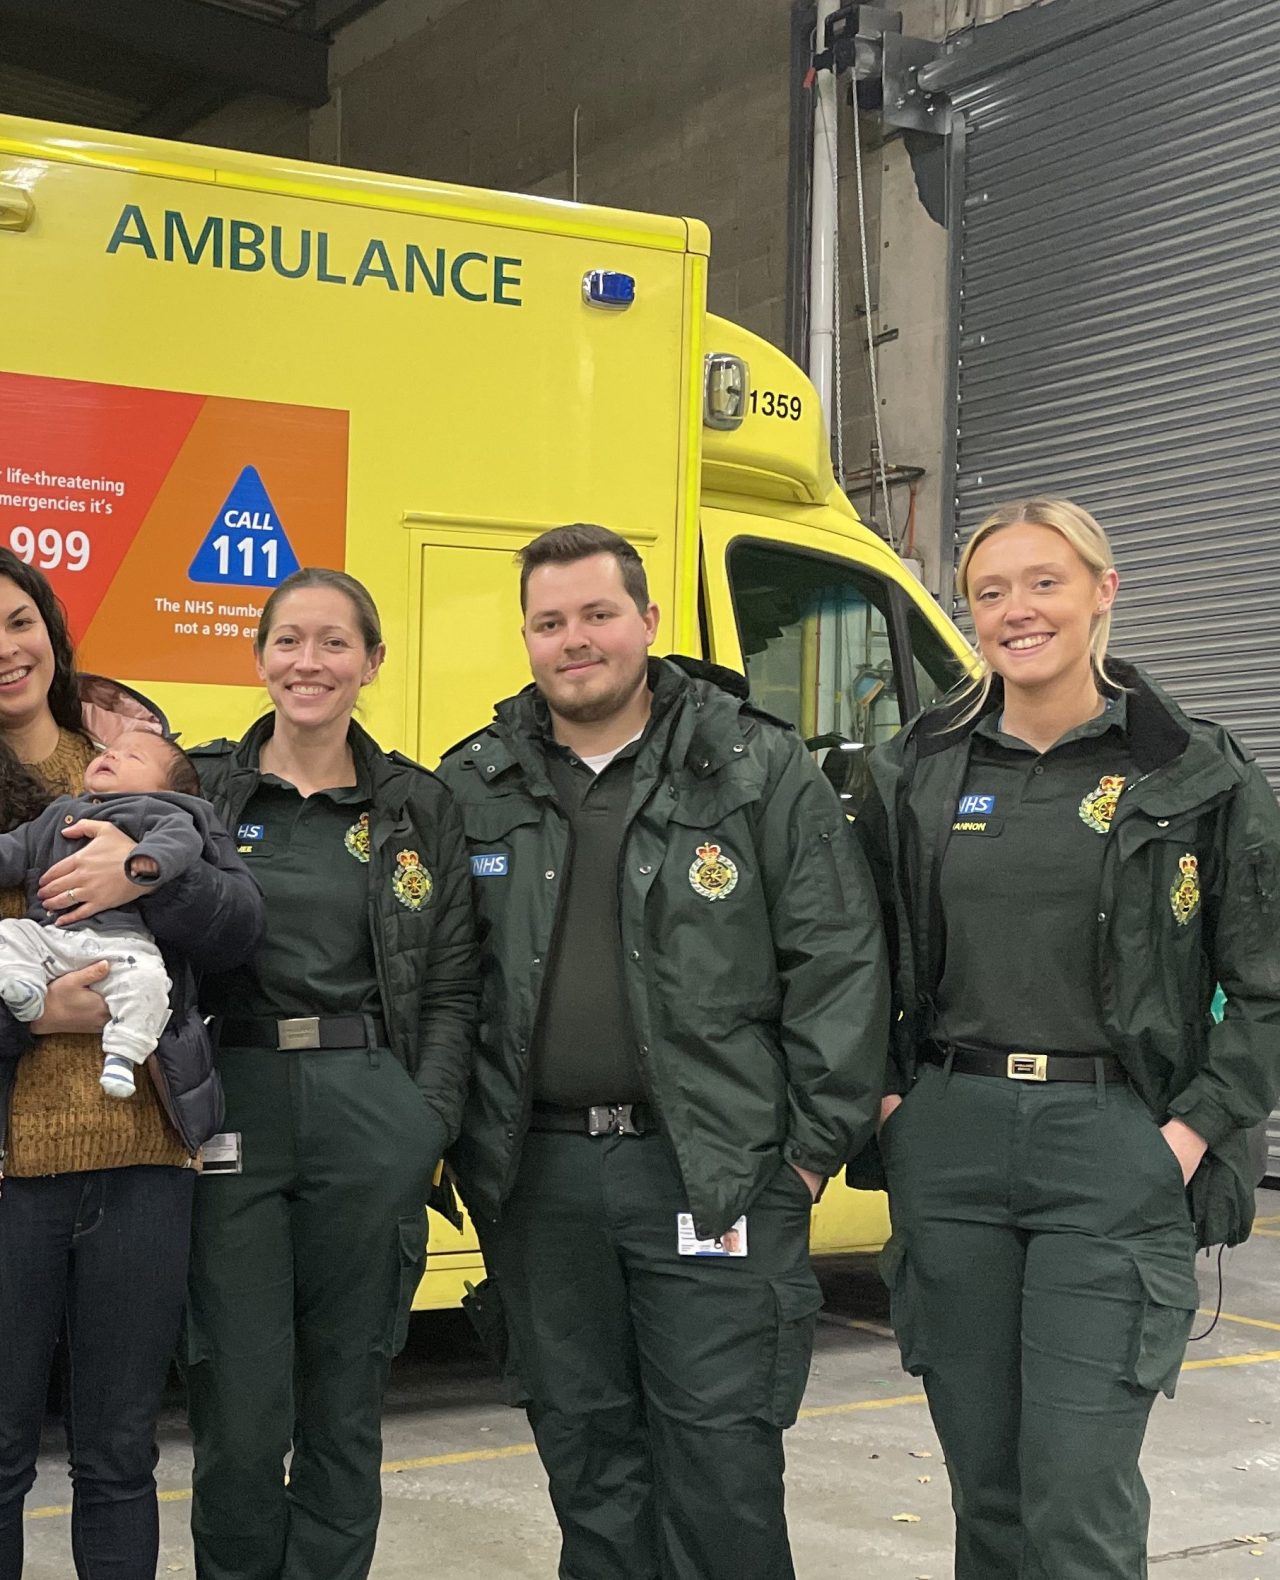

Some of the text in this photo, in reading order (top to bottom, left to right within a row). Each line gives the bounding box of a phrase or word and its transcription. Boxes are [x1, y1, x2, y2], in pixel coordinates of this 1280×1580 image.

[106, 204, 522, 307] AMBULANCE
[750, 390, 802, 421] 1359
[6, 467, 125, 497] life-threatening
[224, 510, 274, 531] CALL
[9, 526, 91, 572] 999
[212, 535, 278, 578] 111
[154, 597, 264, 618] The NHS numbe
[174, 622, 198, 635] not
[202, 625, 210, 635] a
[214, 623, 239, 637] 999
[237, 824, 261, 838] HS
[952, 822, 987, 831] ANNON
[473, 856, 505, 872] NHS
